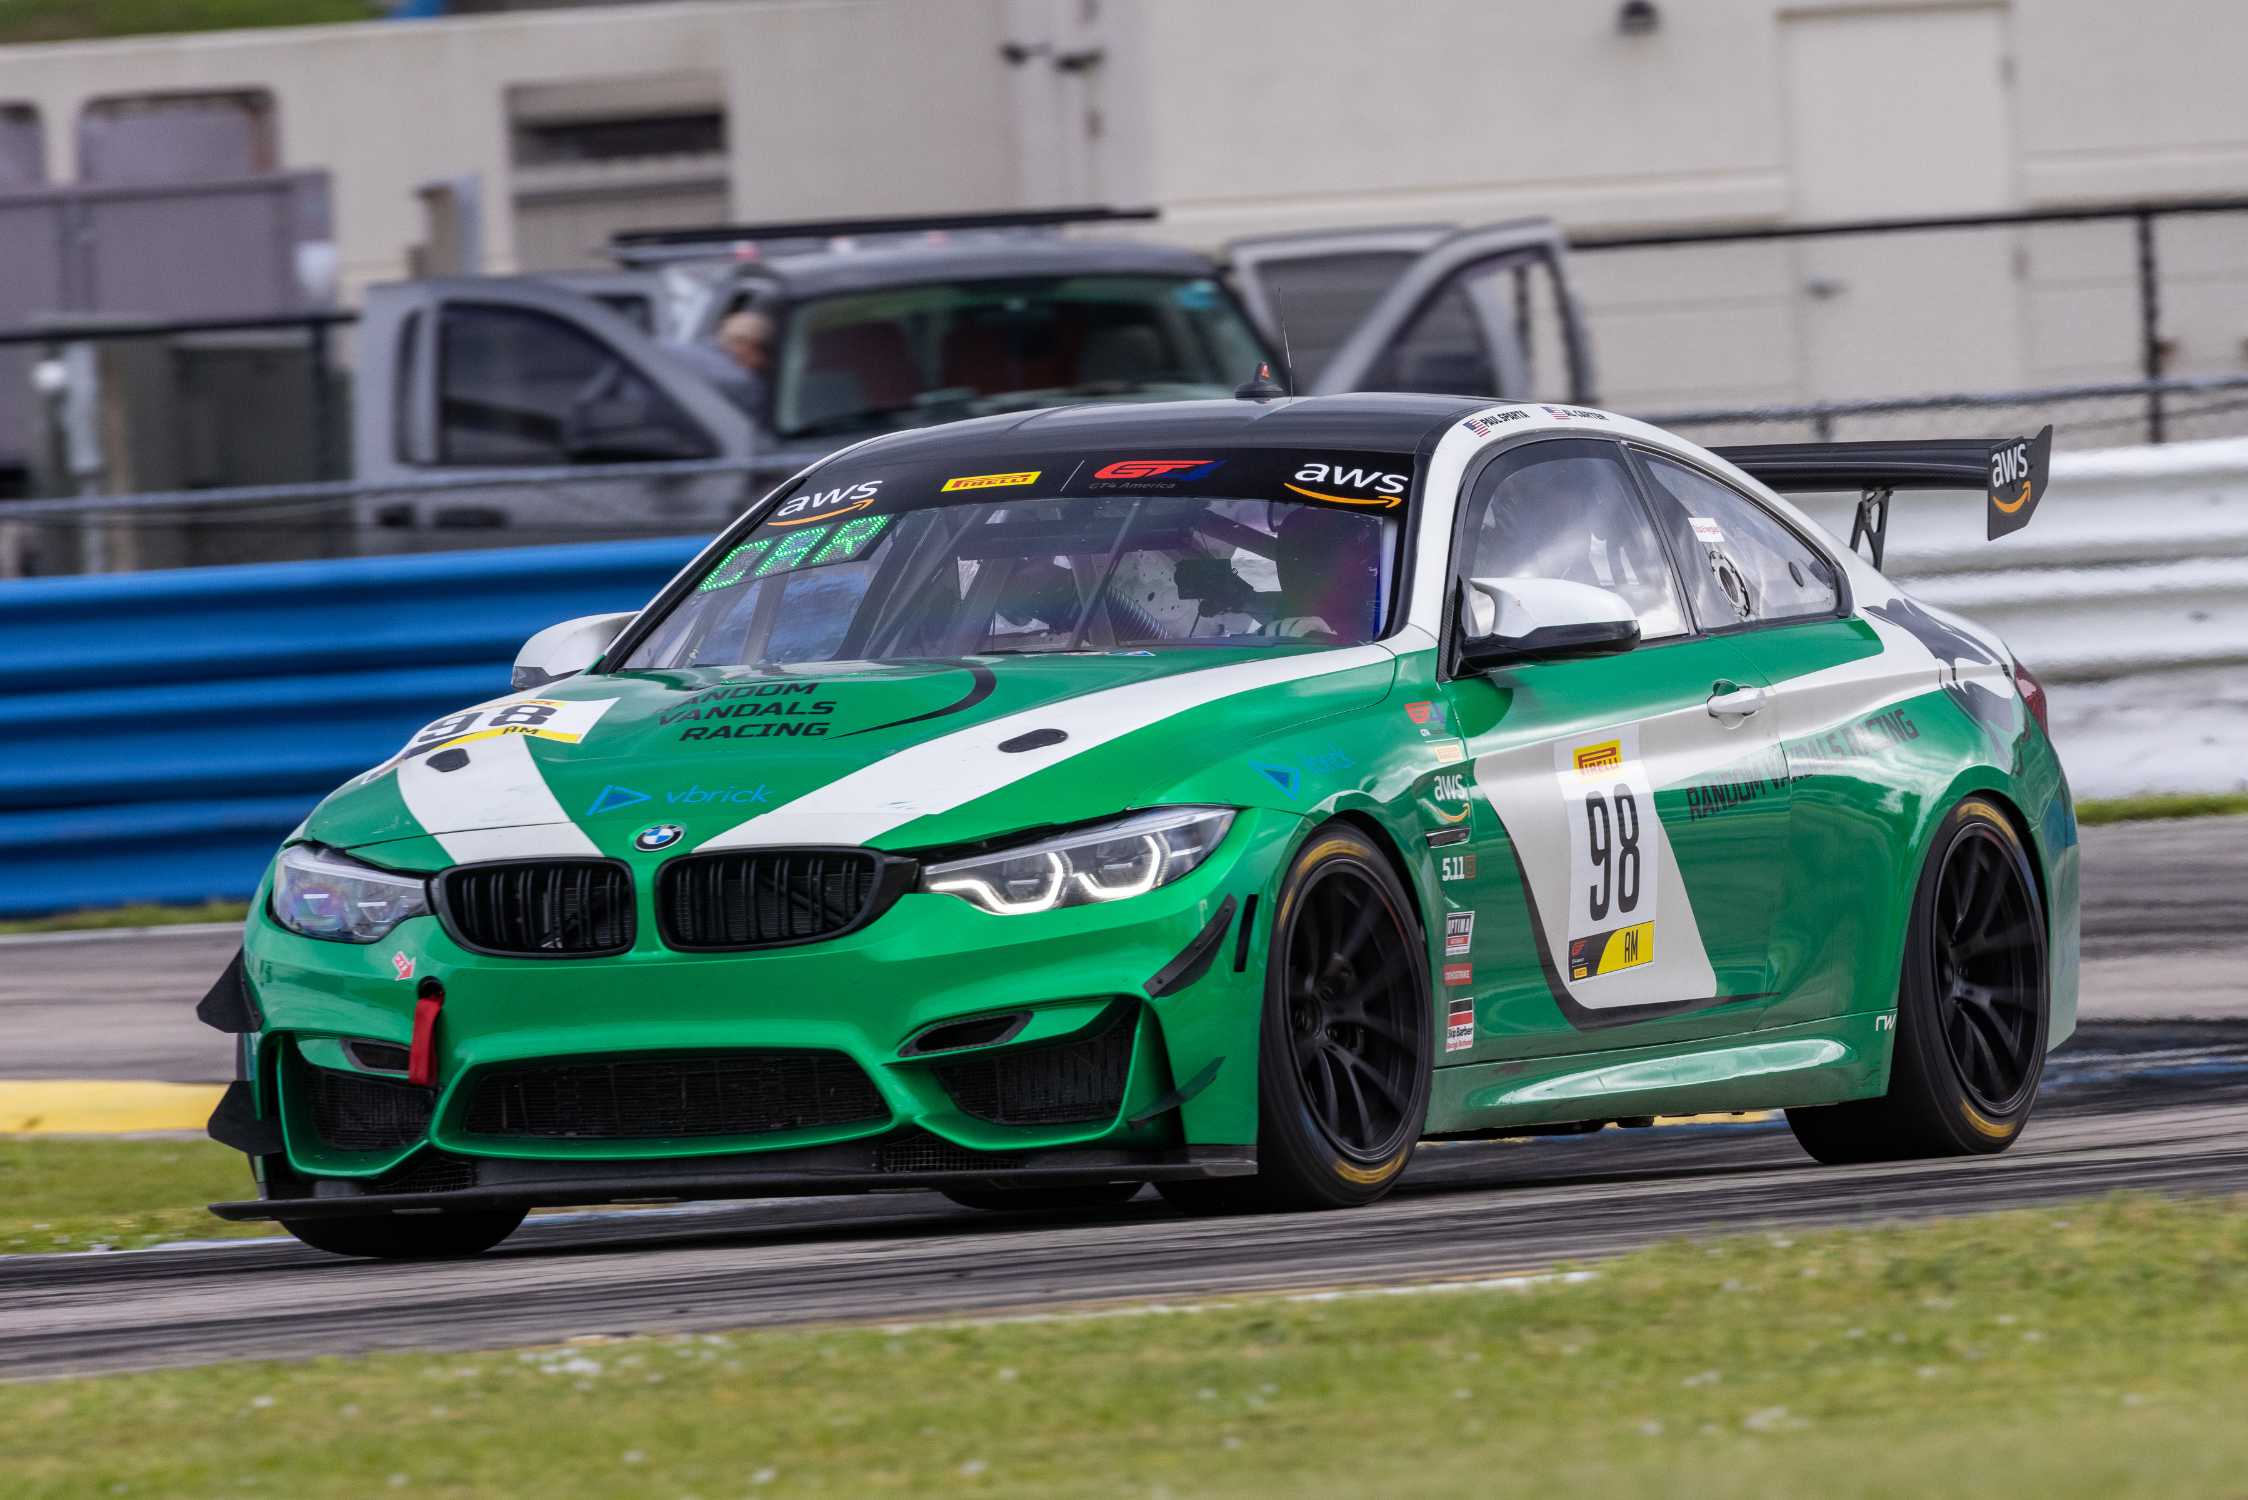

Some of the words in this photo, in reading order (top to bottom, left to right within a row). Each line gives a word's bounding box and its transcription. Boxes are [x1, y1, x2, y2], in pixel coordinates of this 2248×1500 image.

[951, 473, 1032, 488] PIRELLI
[1294, 462, 1409, 494] aws
[1992, 443, 2028, 488] aws
[777, 480, 883, 517] aws
[1120, 482, 1176, 490] America
[700, 513, 888, 593] CAR
[416, 704, 558, 743] 98
[659, 701, 837, 726] VANDALS
[502, 725, 540, 736] AM
[679, 722, 832, 742] RACING
[666, 783, 774, 805] vbrick
[1434, 774, 1468, 802] aws
[1585, 783, 1642, 922] 98
[1624, 928, 1639, 964] AM
